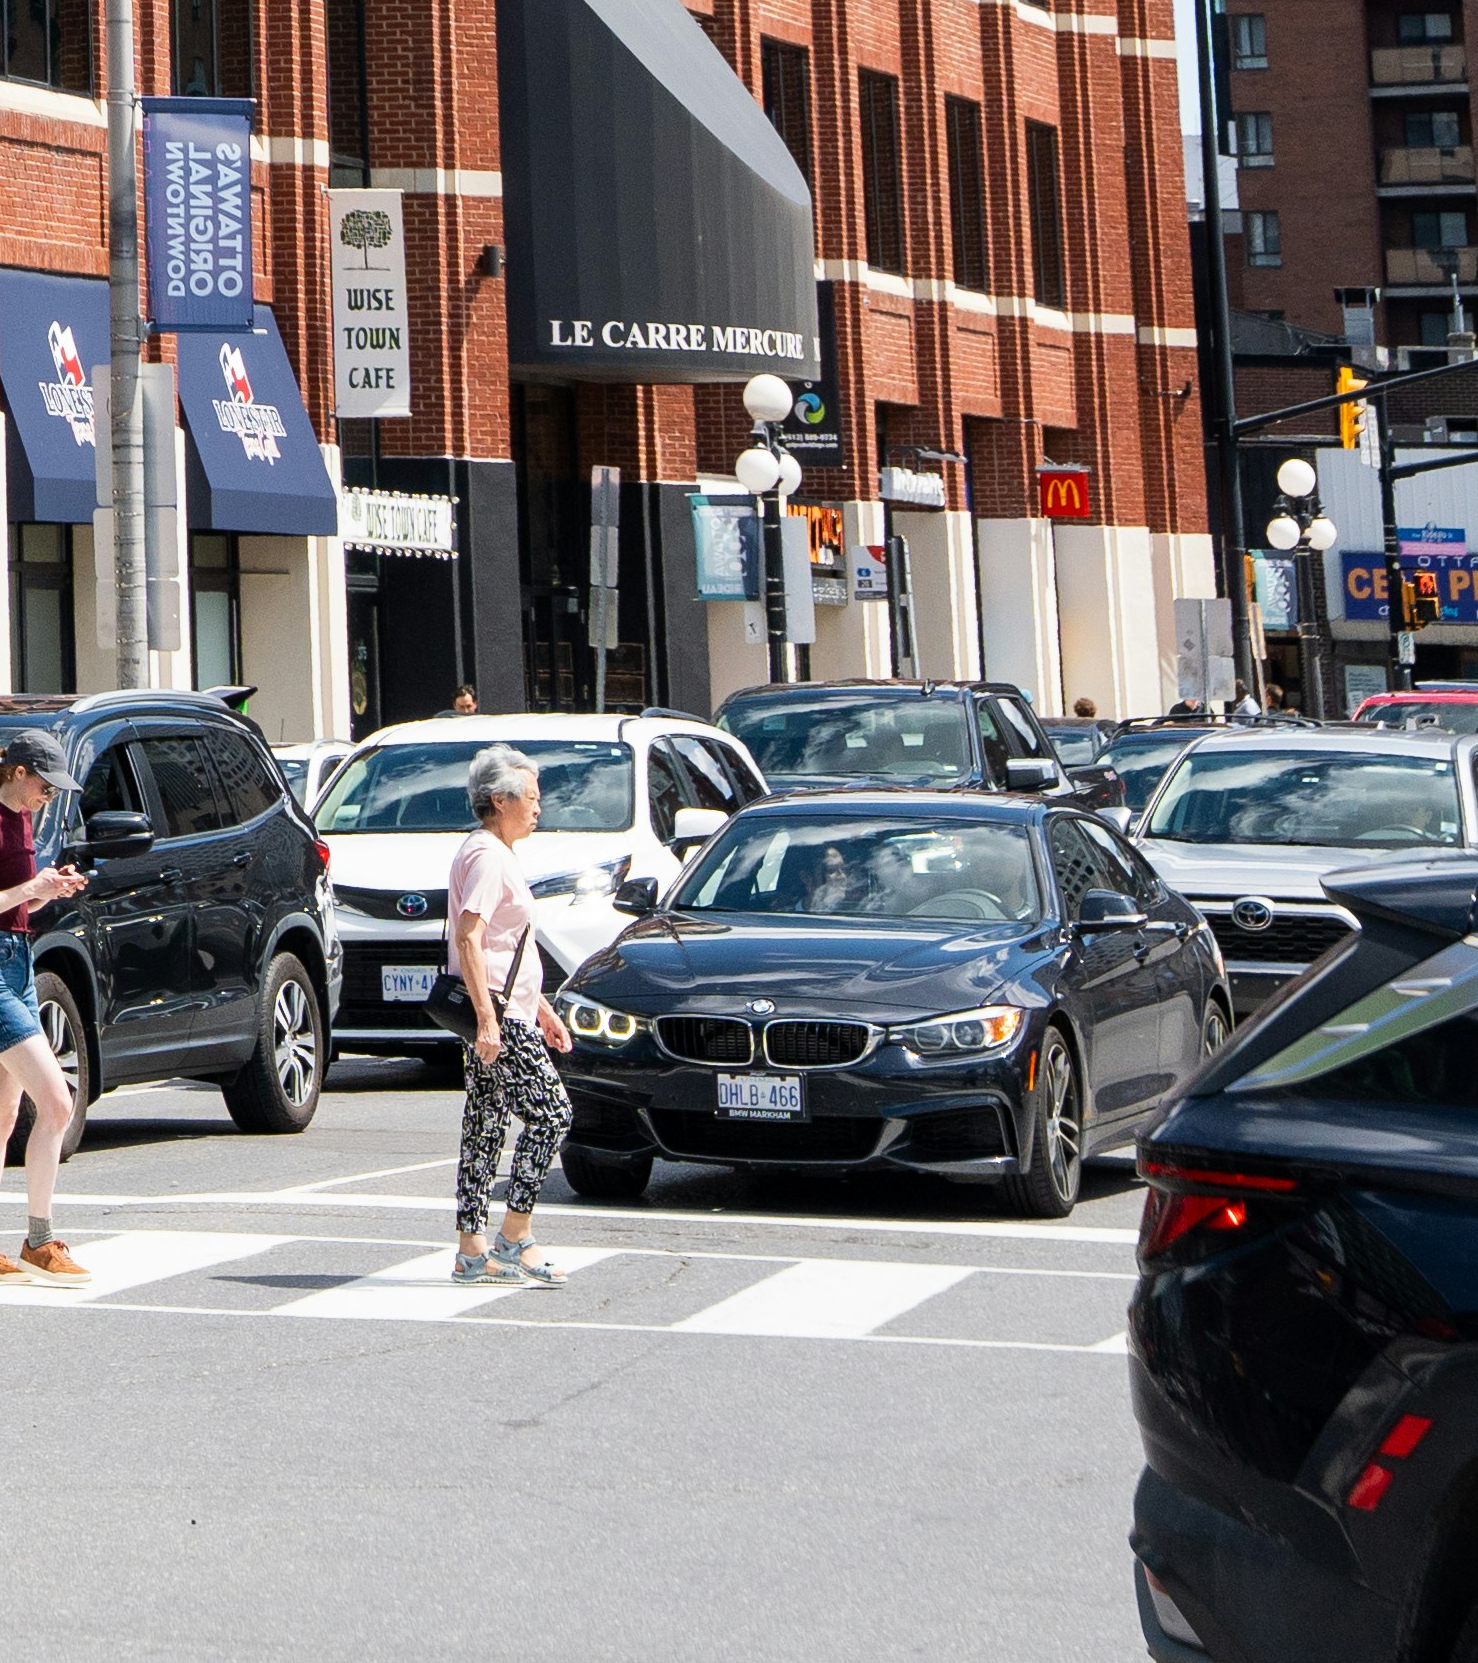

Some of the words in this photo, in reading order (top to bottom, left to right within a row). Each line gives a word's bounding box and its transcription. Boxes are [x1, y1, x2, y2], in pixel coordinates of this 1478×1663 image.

[346, 288, 395, 311] WISE
[343, 327, 401, 350] TOWN
[549, 319, 594, 347] LE
[601, 321, 706, 351] CARRE
[711, 326, 804, 360] MERCURE
[348, 367, 395, 389] CAFE
[39, 382, 85, 417] LONE
[212, 399, 254, 433] LONE
[366, 503, 388, 540] WISE
[390, 504, 415, 542] TOWN
[1417, 556, 1478, 567] OTTA
[1347, 568, 1390, 599] CE
[384, 974, 414, 992] CYNY
[719, 1083, 759, 1106] DHLB
[769, 1085, 798, 1108] 466
[729, 1109, 748, 1117] BMW
[750, 1110, 791, 1119] MARKHAM
